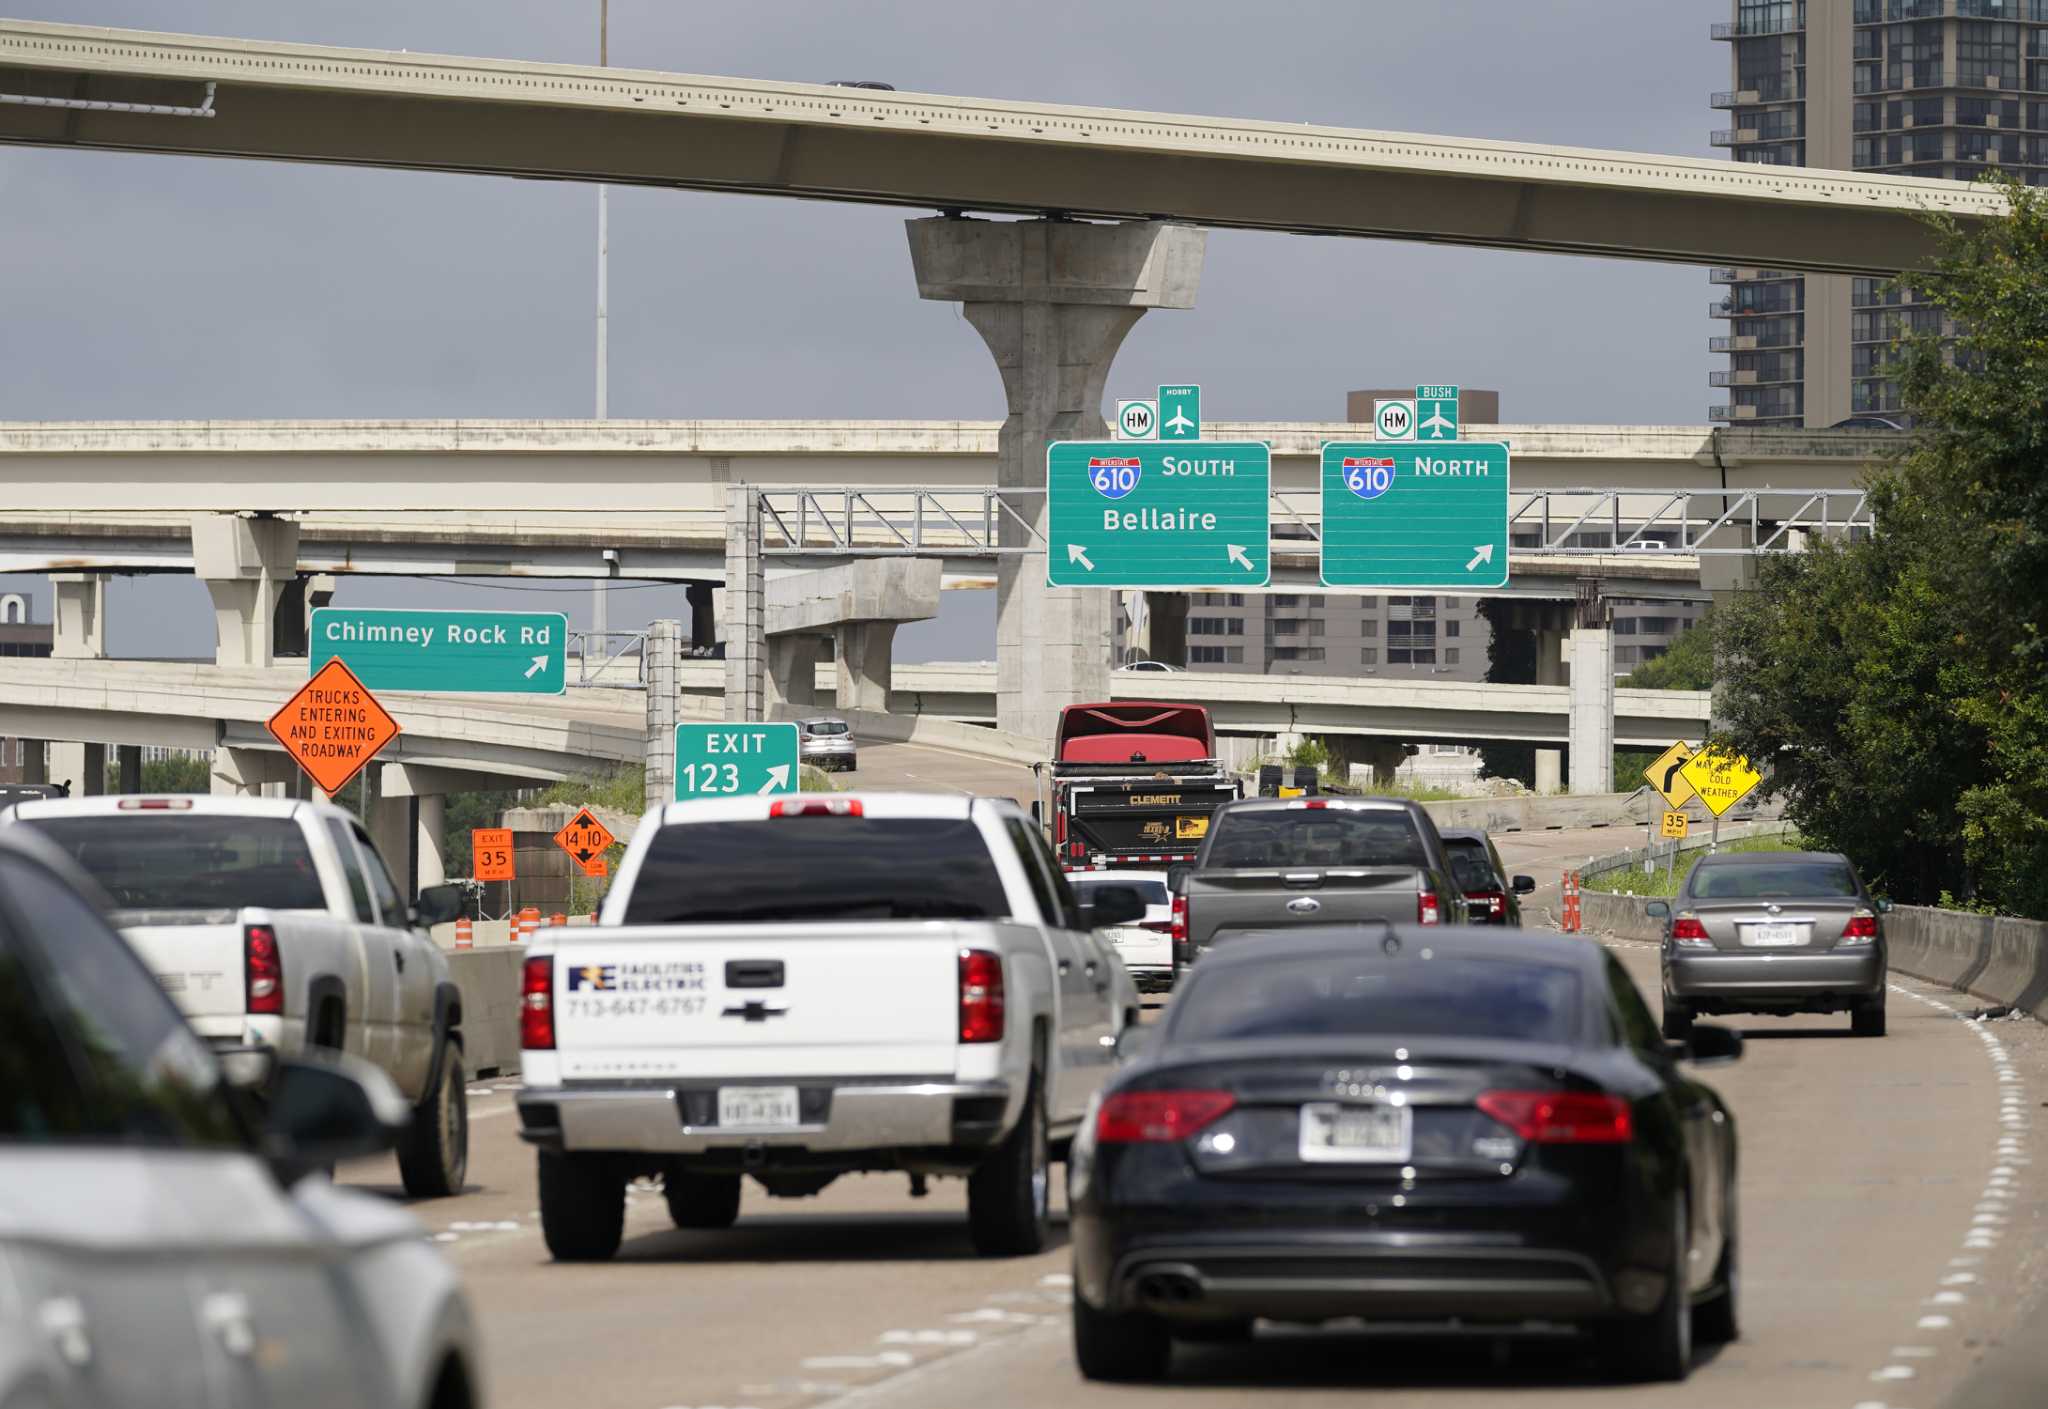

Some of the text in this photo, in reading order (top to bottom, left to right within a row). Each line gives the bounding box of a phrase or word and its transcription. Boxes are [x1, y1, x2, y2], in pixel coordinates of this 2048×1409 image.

[1423, 386, 1452, 398] BUSH
[1127, 412, 1148, 427] HM
[1384, 413, 1406, 428] HM
[1161, 456, 1235, 477] SOUTH
[1415, 456, 1489, 477] NORTH
[1094, 467, 1136, 491] 610
[1348, 467, 1390, 491] 610
[1103, 508, 1218, 531] Bellaire
[325, 621, 551, 647] Chimney Rock Rd
[308, 689, 360, 705] TRUCKS
[300, 707, 367, 723] ENTERING
[290, 725, 376, 741] AND EXITING
[301, 743, 362, 758] ROADWAY
[706, 732, 766, 754] EXIT
[1696, 760, 1713, 770] MAY
[683, 764, 739, 793] 123
[1709, 775, 1731, 785] COLD
[1129, 794, 1182, 805] CLEMENT
[1700, 786, 1738, 798] WEATHER
[1666, 814, 1685, 828] 35
[481, 834, 504, 843] EXIT
[565, 831, 579, 847] 14
[587, 830, 601, 847] 10
[481, 851, 507, 867] 35
